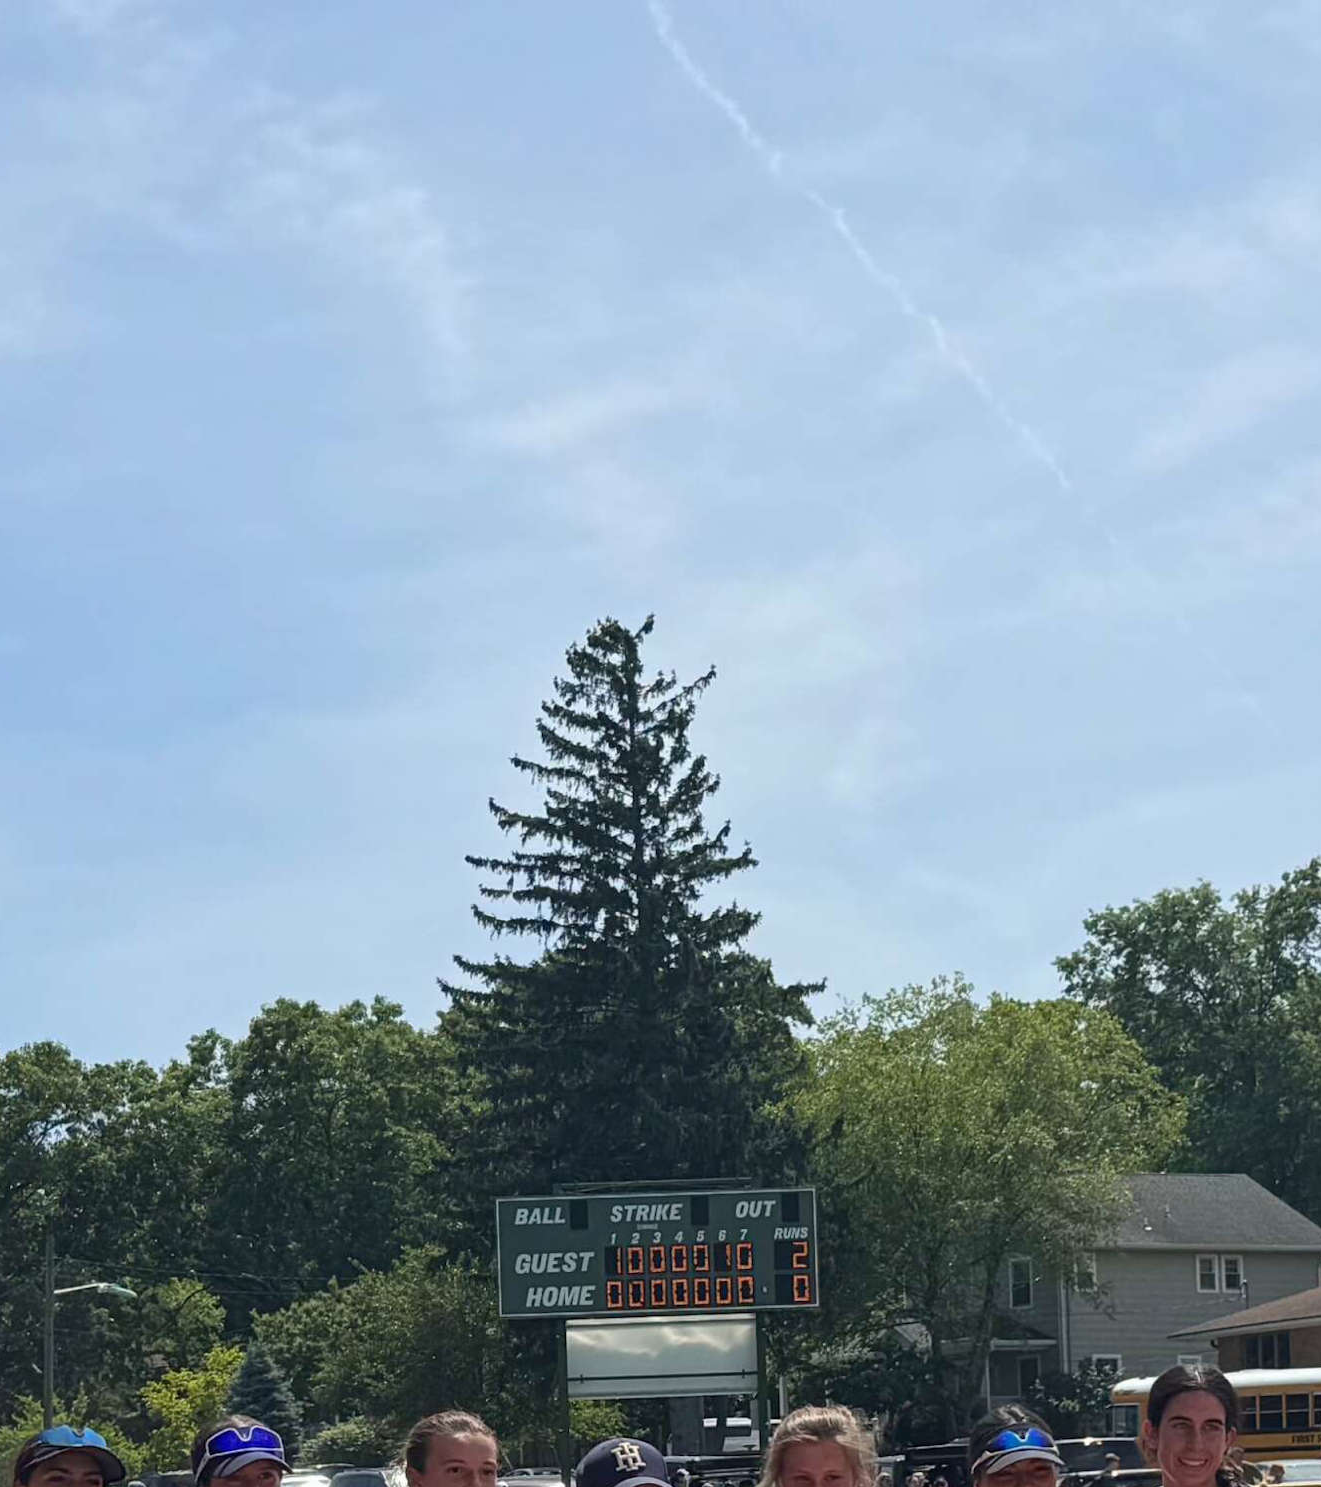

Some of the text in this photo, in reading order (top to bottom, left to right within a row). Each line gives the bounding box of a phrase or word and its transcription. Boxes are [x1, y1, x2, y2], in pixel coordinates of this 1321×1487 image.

[515, 1200, 776, 1225] BALL STRIKE OUT
[611, 1227, 809, 1245] 1 2 3 4 5 6 7 RUNS
[515, 1252, 595, 1274] GUEST
[627, 1247, 645, 1274] 0
[649, 1246, 666, 1273] 0
[671, 1245, 688, 1272] 0
[792, 1241, 808, 1268] 2
[526, 1286, 596, 1308] HOME
[607, 1280, 623, 1308] 0
[629, 1280, 646, 1307] 0
[651, 1279, 667, 1306] 0
[672, 1278, 689, 1305] 0
[694, 1277, 710, 1304] 0
[716, 1277, 732, 1304] 0
[793, 1274, 810, 1302] 0
[1291, 1434, 1316, 1445] FIRST
